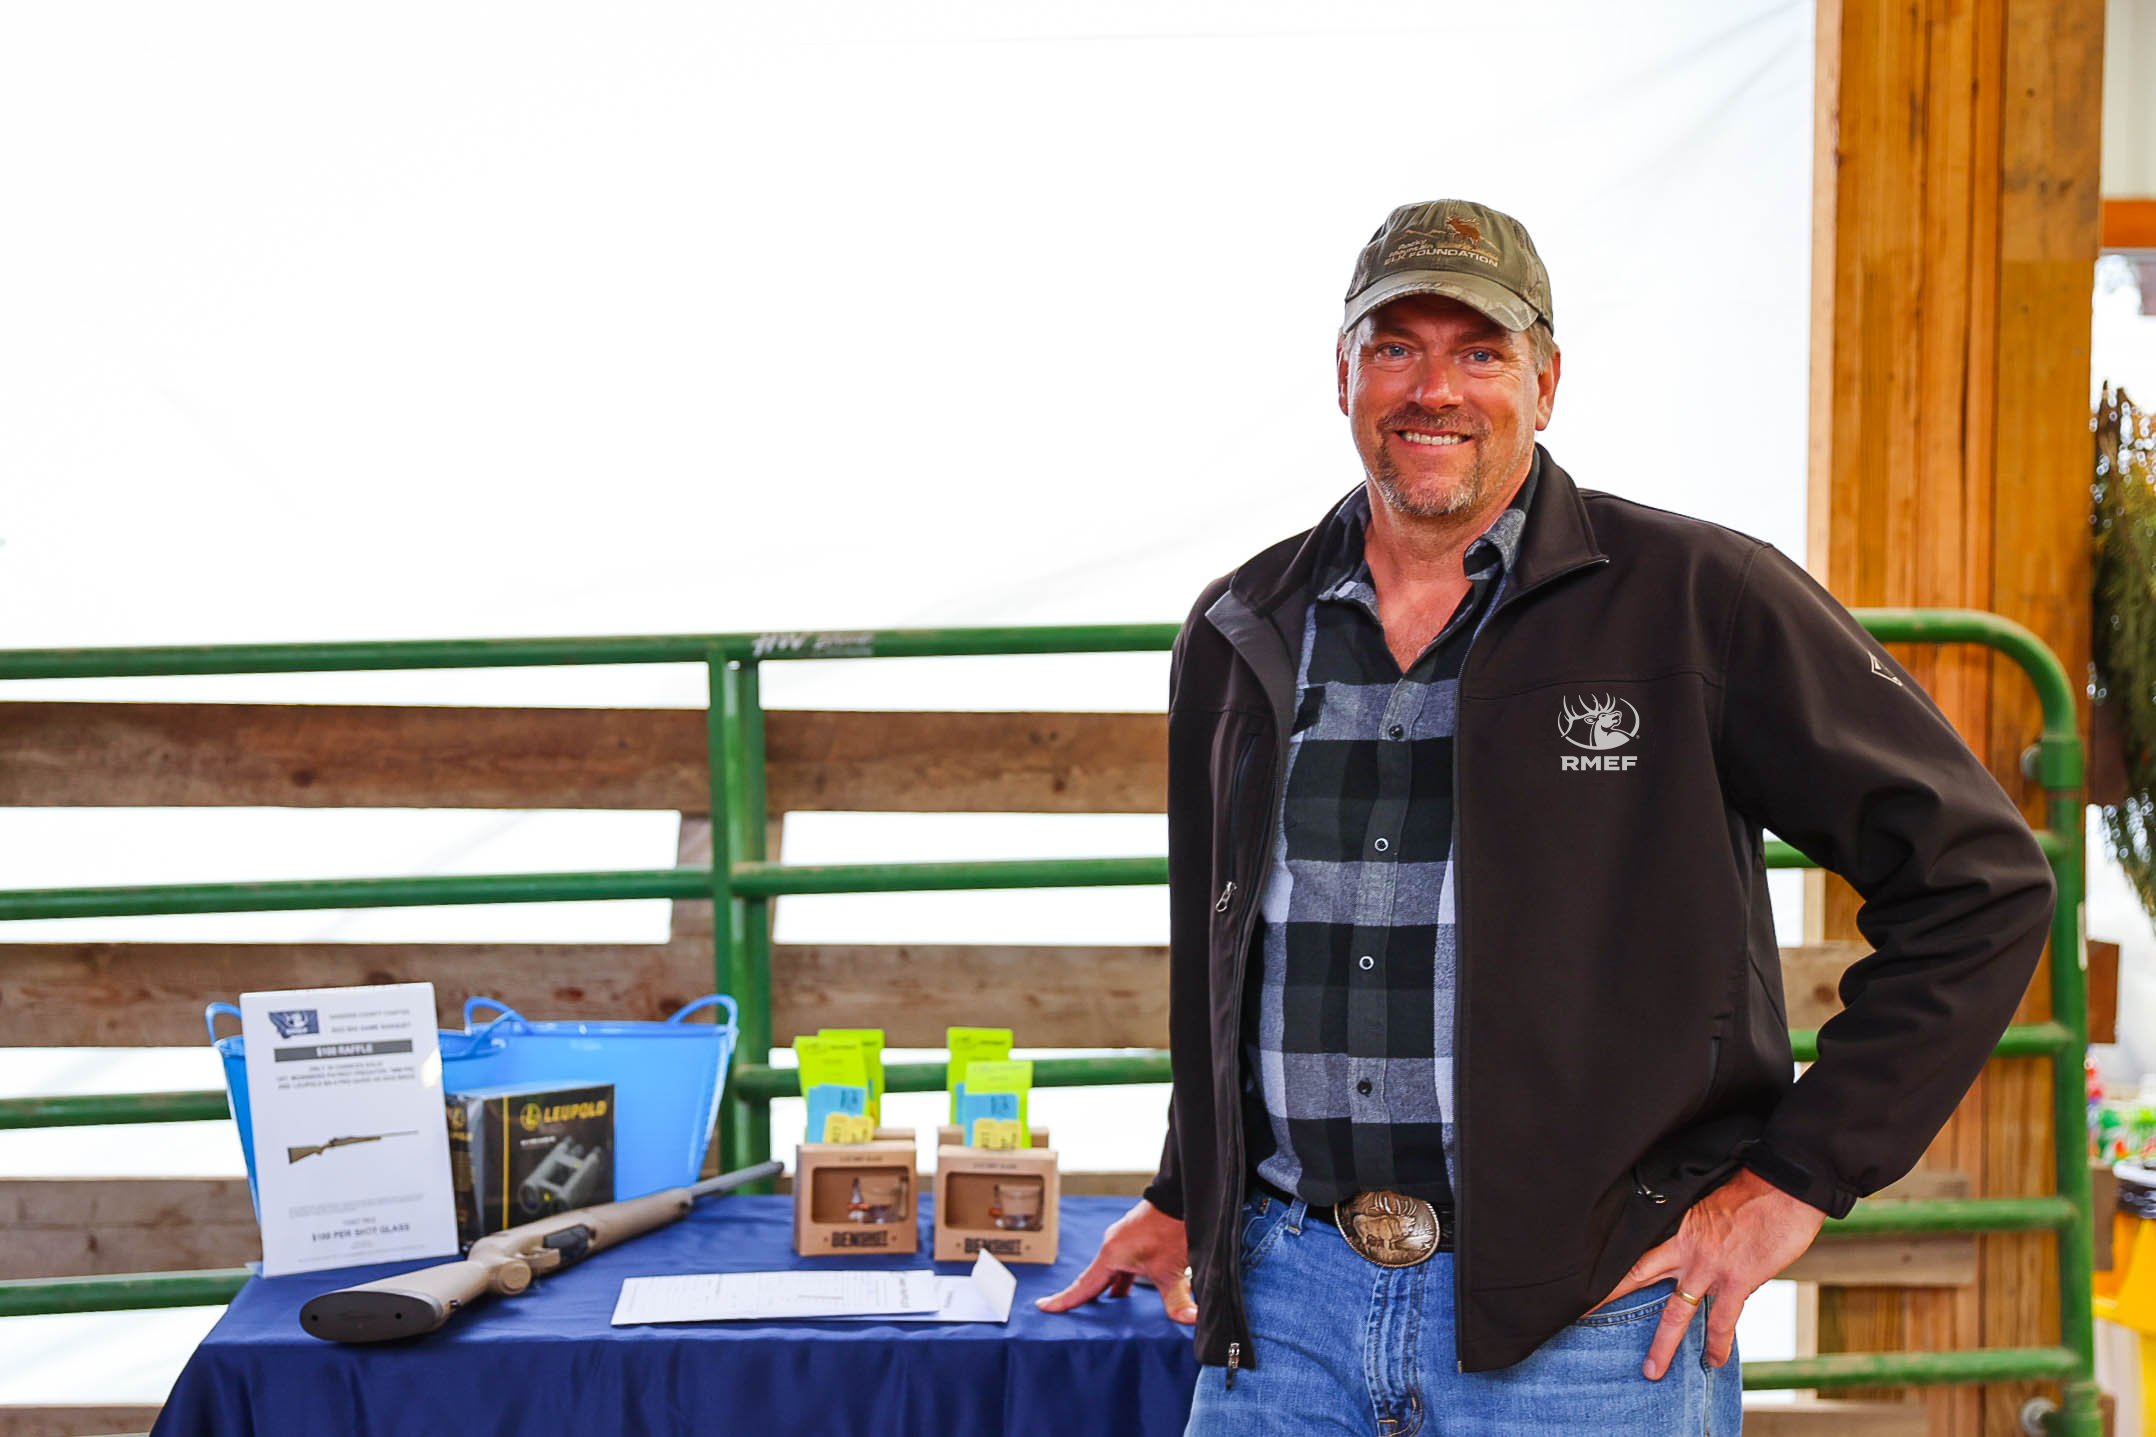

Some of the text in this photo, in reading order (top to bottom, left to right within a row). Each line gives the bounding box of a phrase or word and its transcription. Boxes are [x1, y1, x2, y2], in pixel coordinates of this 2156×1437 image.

[1384, 248, 1499, 268] ELK FOUNDATION
[1560, 755, 1638, 771] RMEF
[338, 1043, 374, 1056] RAFFLE
[543, 1100, 608, 1123] LEUPOLD
[334, 1229, 352, 1238] PER
[355, 1225, 378, 1236] SHOT
[380, 1222, 411, 1233] GLASS
